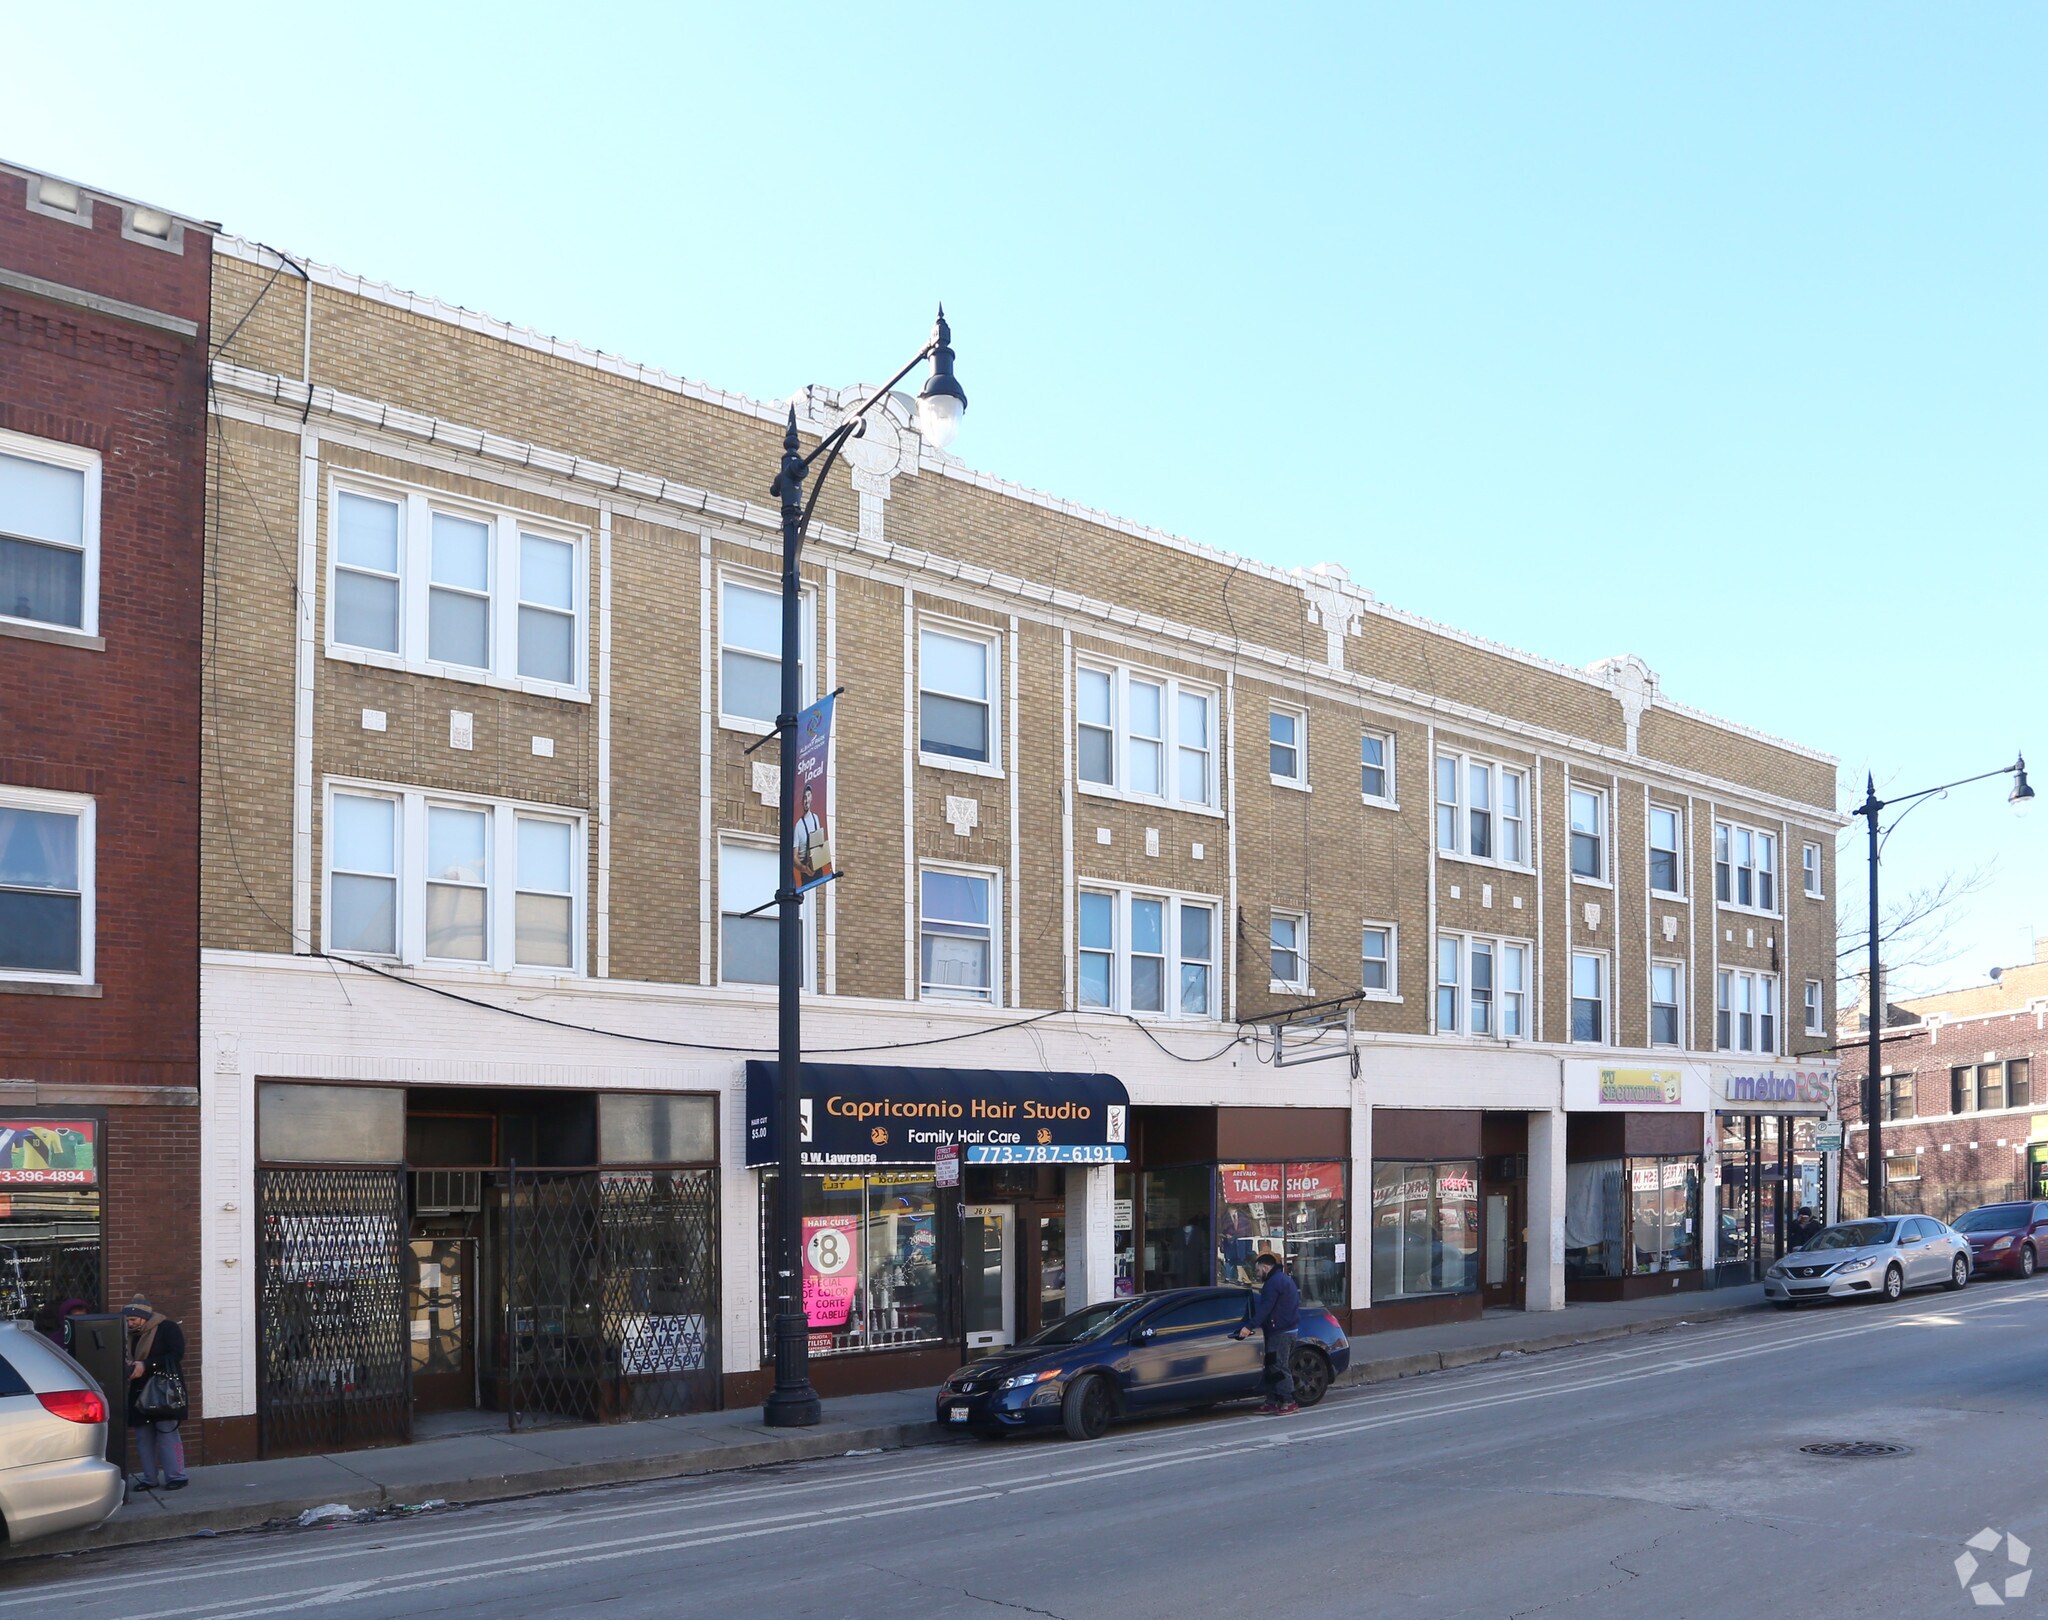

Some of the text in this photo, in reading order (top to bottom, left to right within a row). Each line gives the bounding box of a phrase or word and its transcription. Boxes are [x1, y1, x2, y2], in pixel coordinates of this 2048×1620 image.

[798, 757, 815, 775] Shop
[804, 760, 823, 783] Local
[1601, 1070, 1616, 1084] TU
[1601, 1084, 1662, 1102] SEGUNDITA
[1735, 1070, 1830, 1102] metroPCS
[826, 1095, 1091, 1122] Capricornio Hair Studio
[752, 1127, 767, 1139] $5.00
[908, 1129, 1021, 1146] Family Hair Care
[810, 1153, 823, 1163] W.
[826, 1153, 877, 1163] Lawrence
[978, 1146, 1114, 1162] 773-787-6191
[1233, 1177, 1320, 1192] TAILOR SHOP
[808, 1218, 849, 1228] HAIR CUTS
[802, 1278, 842, 1289] ESPECIAL
[818, 1287, 848, 1297] COLOR
[816, 1298, 845, 1308] CORTE
[816, 1310, 849, 1320] CABELLO
[643, 1318, 686, 1334] SPACE
[659, 1332, 701, 1347] LEASE
